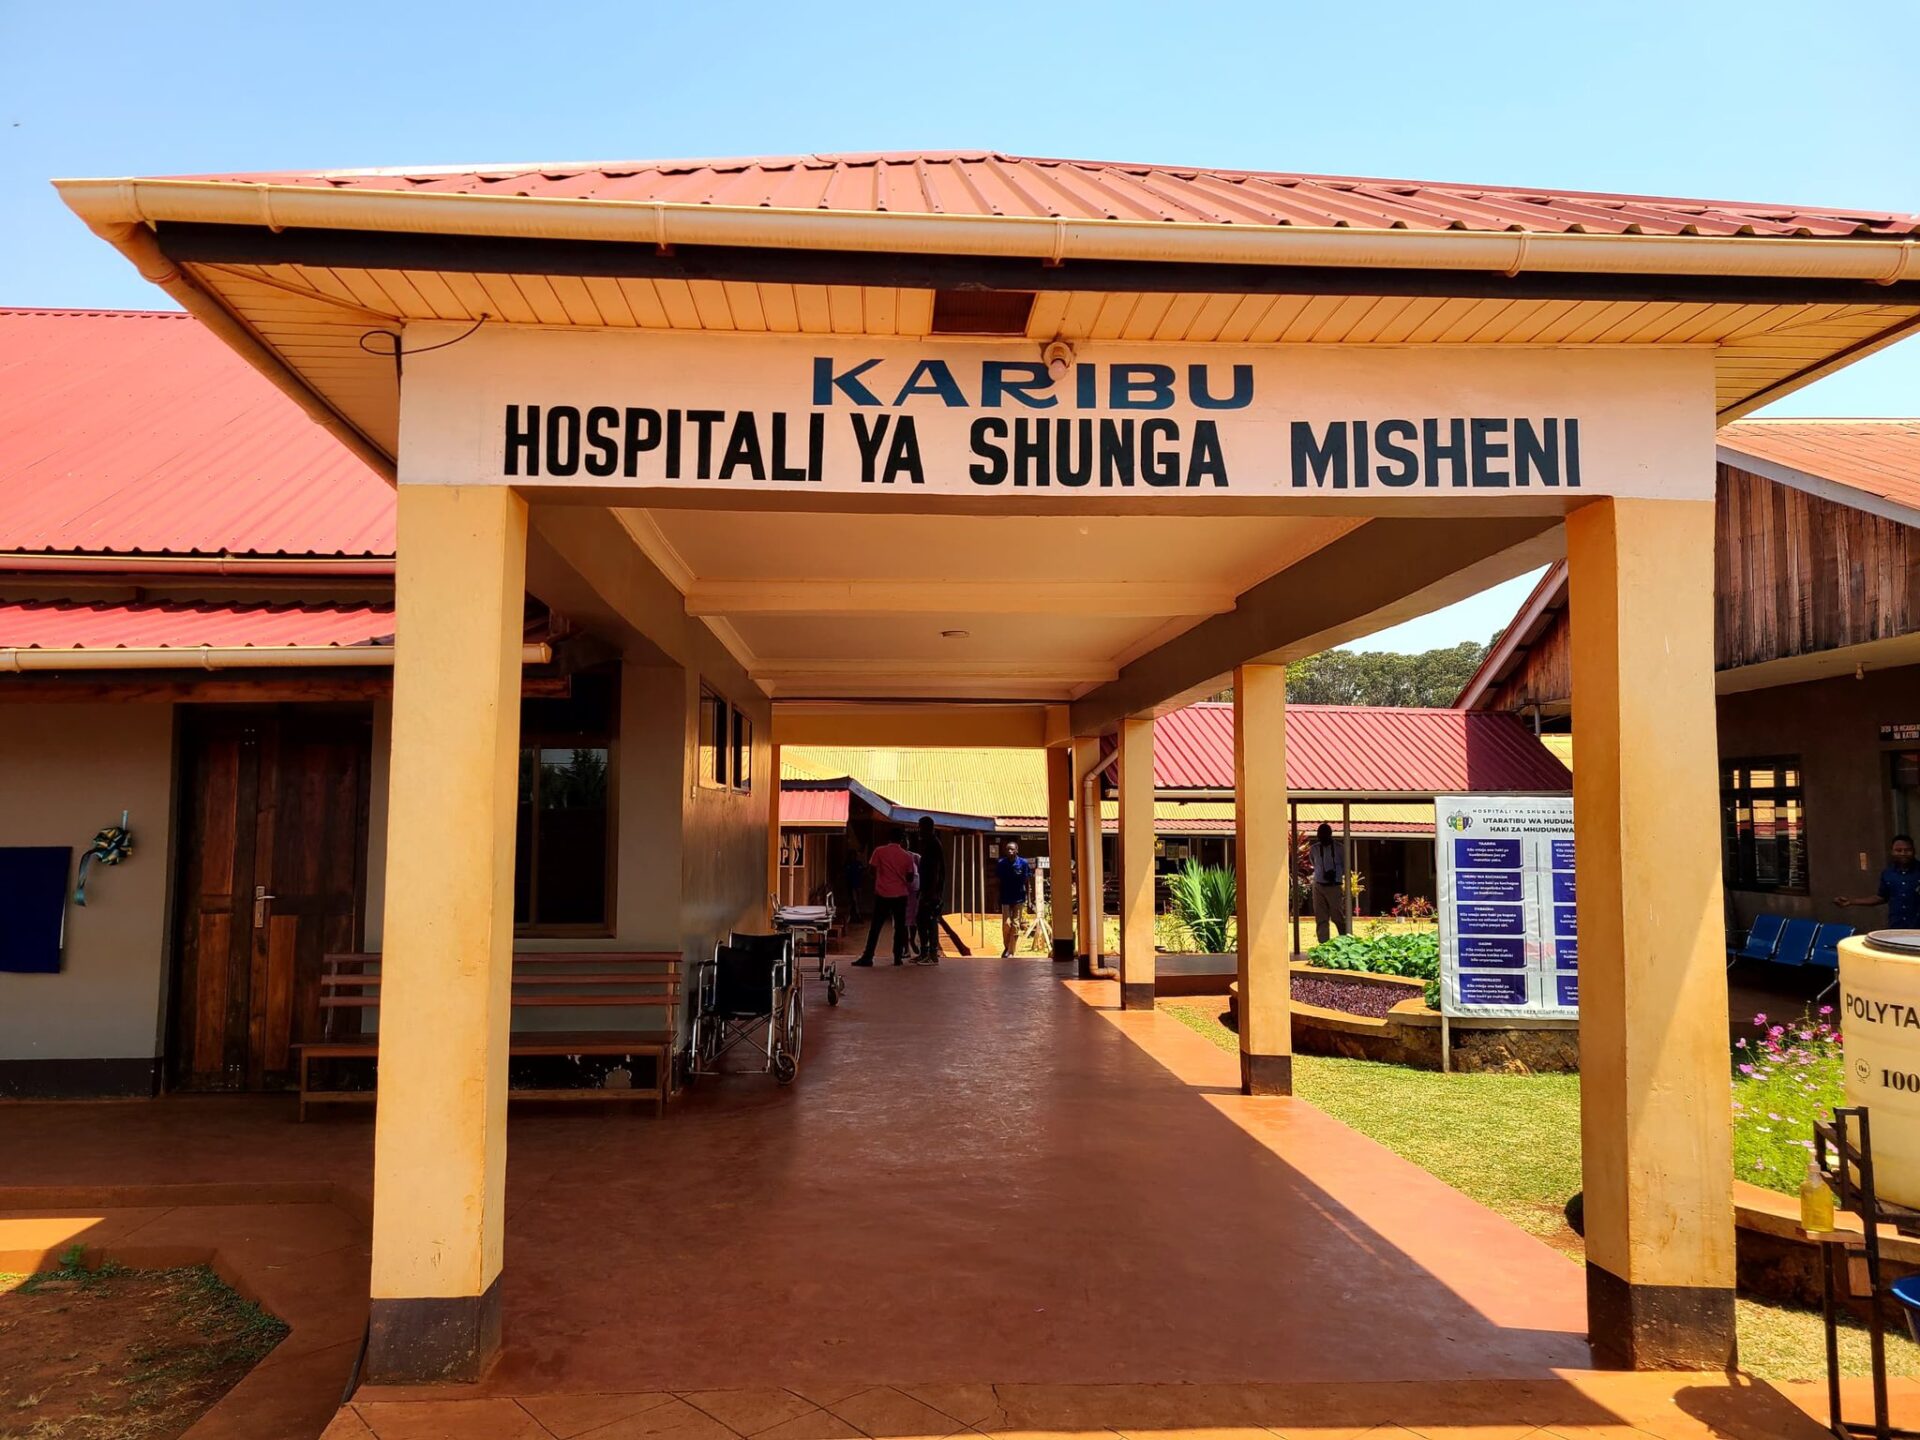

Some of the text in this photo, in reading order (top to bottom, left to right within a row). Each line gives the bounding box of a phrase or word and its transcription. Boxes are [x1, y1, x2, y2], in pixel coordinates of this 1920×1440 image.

[812, 356, 1254, 410] KARIBU
[504, 404, 1581, 488] HOSPITALI YA SHUNGA MISHENI
[1846, 992, 1920, 1029] POLYTA
[1881, 1068, 1920, 1093] 100
